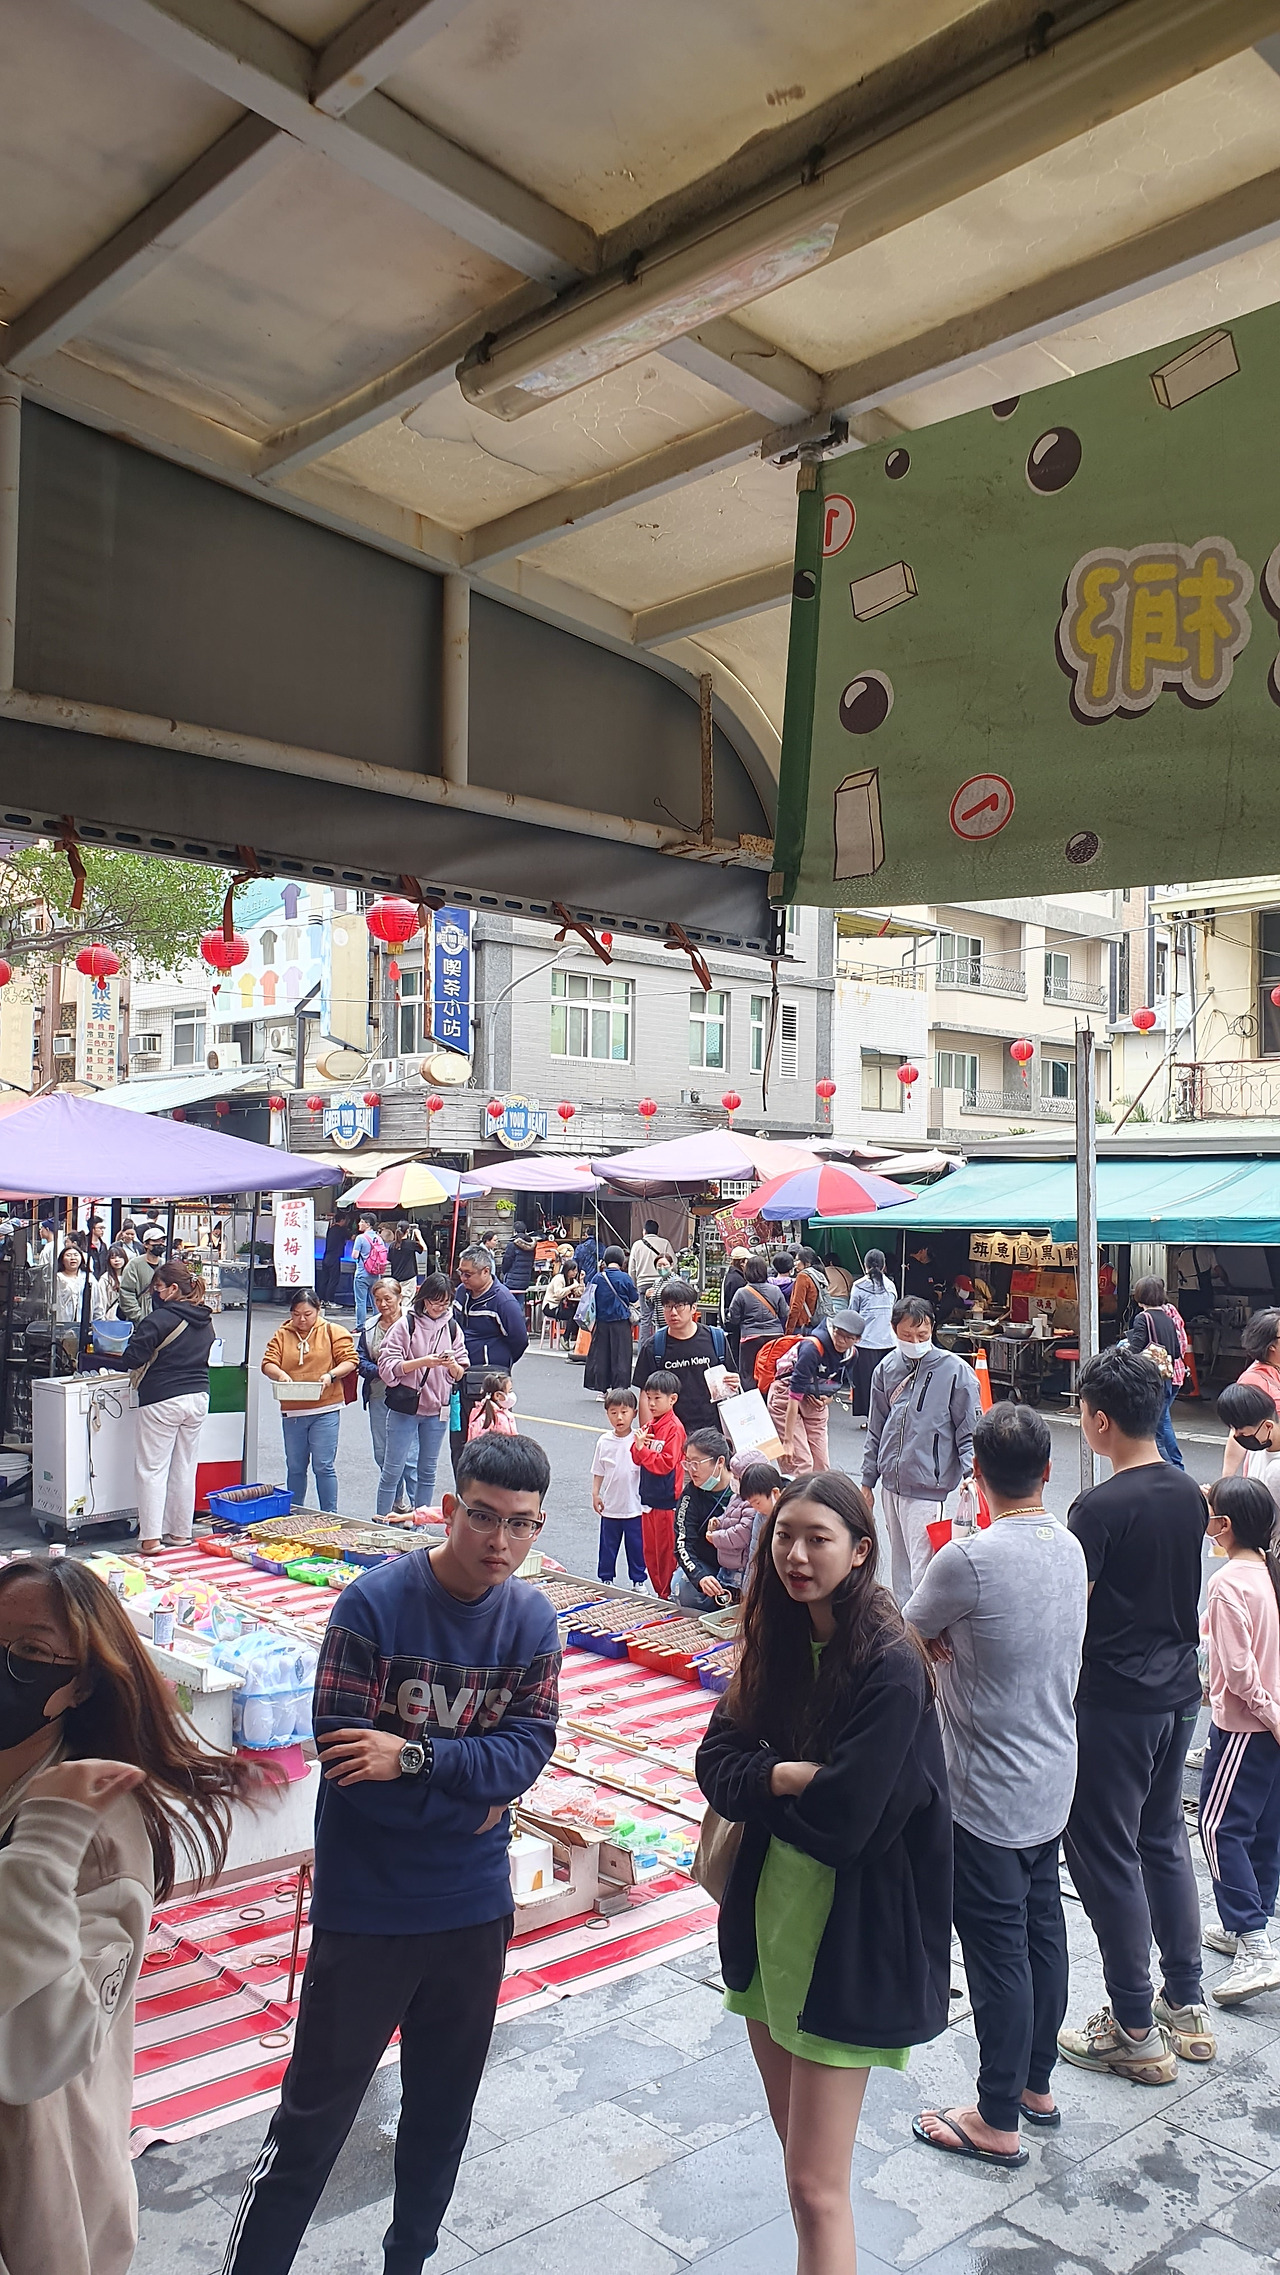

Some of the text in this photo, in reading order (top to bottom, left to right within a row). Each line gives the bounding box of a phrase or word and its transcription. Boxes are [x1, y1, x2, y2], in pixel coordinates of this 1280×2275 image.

[442, 958, 462, 1038] 喫茶小站
[86, 1039, 115, 1048] 三色布丁
[509, 1111, 526, 1129] YOUR
[527, 1112, 547, 1138] HEART
[282, 1211, 302, 1284] 酸梅湯
[664, 1355, 711, 1370] Calvin Klein
